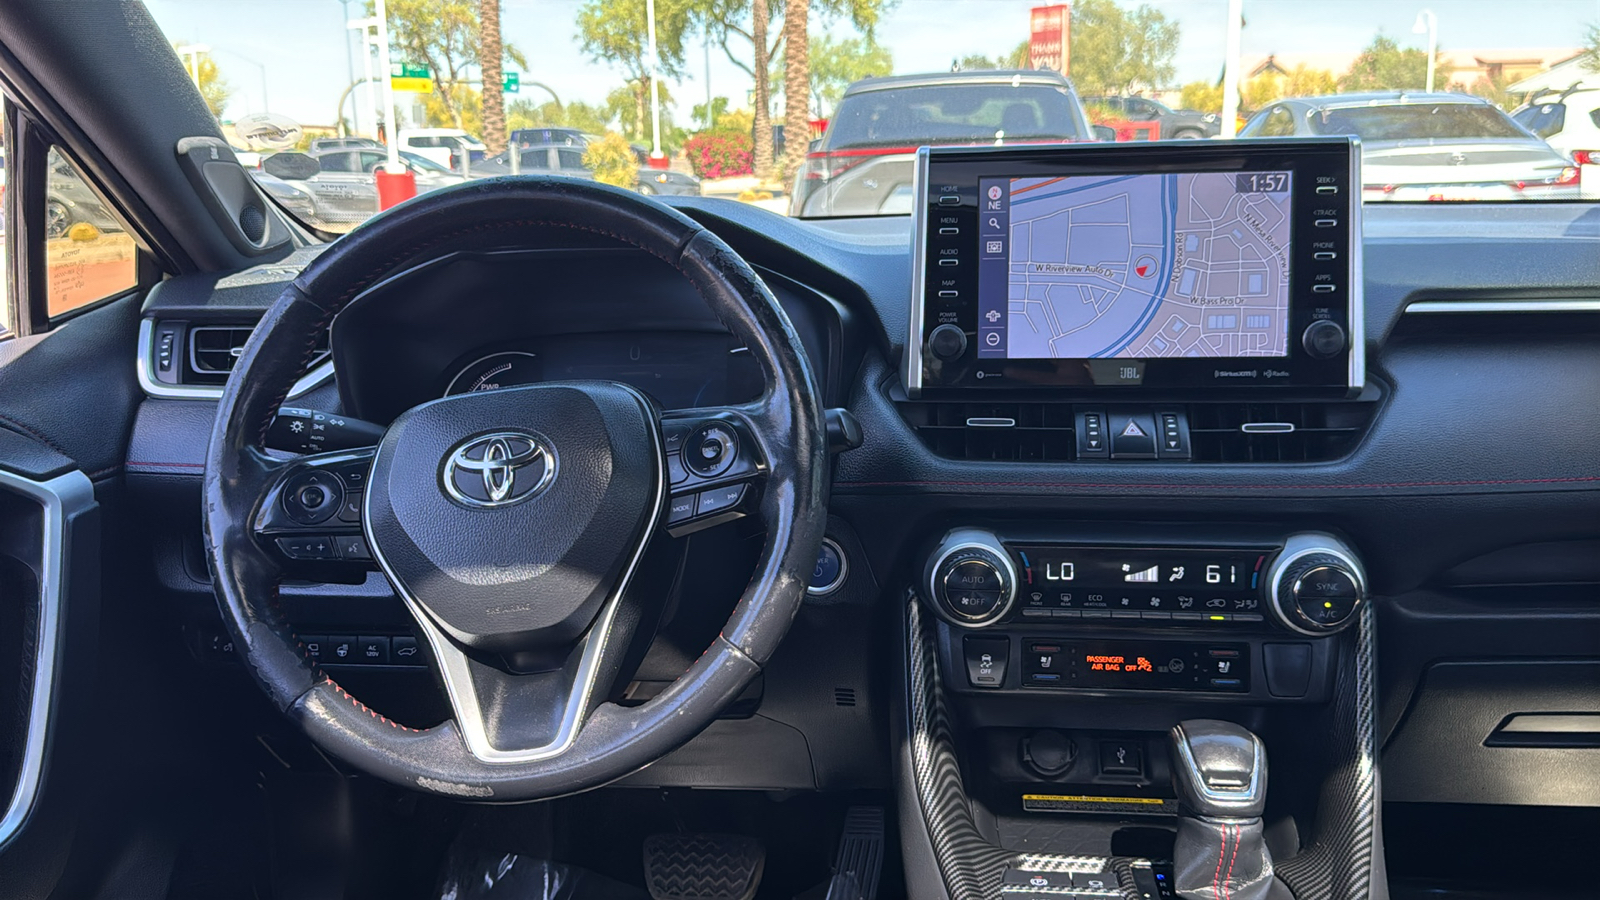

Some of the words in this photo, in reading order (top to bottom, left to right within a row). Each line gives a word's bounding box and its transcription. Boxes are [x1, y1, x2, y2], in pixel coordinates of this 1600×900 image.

[1250, 174, 1286, 192] 1:57
[988, 201, 1001, 210] NE
[1250, 220, 1266, 237] Mesa
[1175, 233, 1183, 243] Rd
[1173, 245, 1183, 273] Dobson
[1046, 264, 1082, 272] Riverview
[1085, 265, 1104, 274] Auto
[1104, 269, 1113, 278] Dr
[1171, 275, 1179, 283] N
[1190, 296, 1197, 304] W
[1200, 297, 1217, 305] Bass
[1120, 367, 1140, 379] JBL
[673, 504, 689, 512] MODE
[1046, 562, 1074, 580] LO
[1206, 564, 1236, 583] 61
[961, 576, 985, 584] AUTO
[1316, 583, 1338, 591] SYNC
[970, 598, 985, 606] OFF
[1319, 610, 1337, 618] A/C
[1086, 655, 1124, 664] PASSENGER
